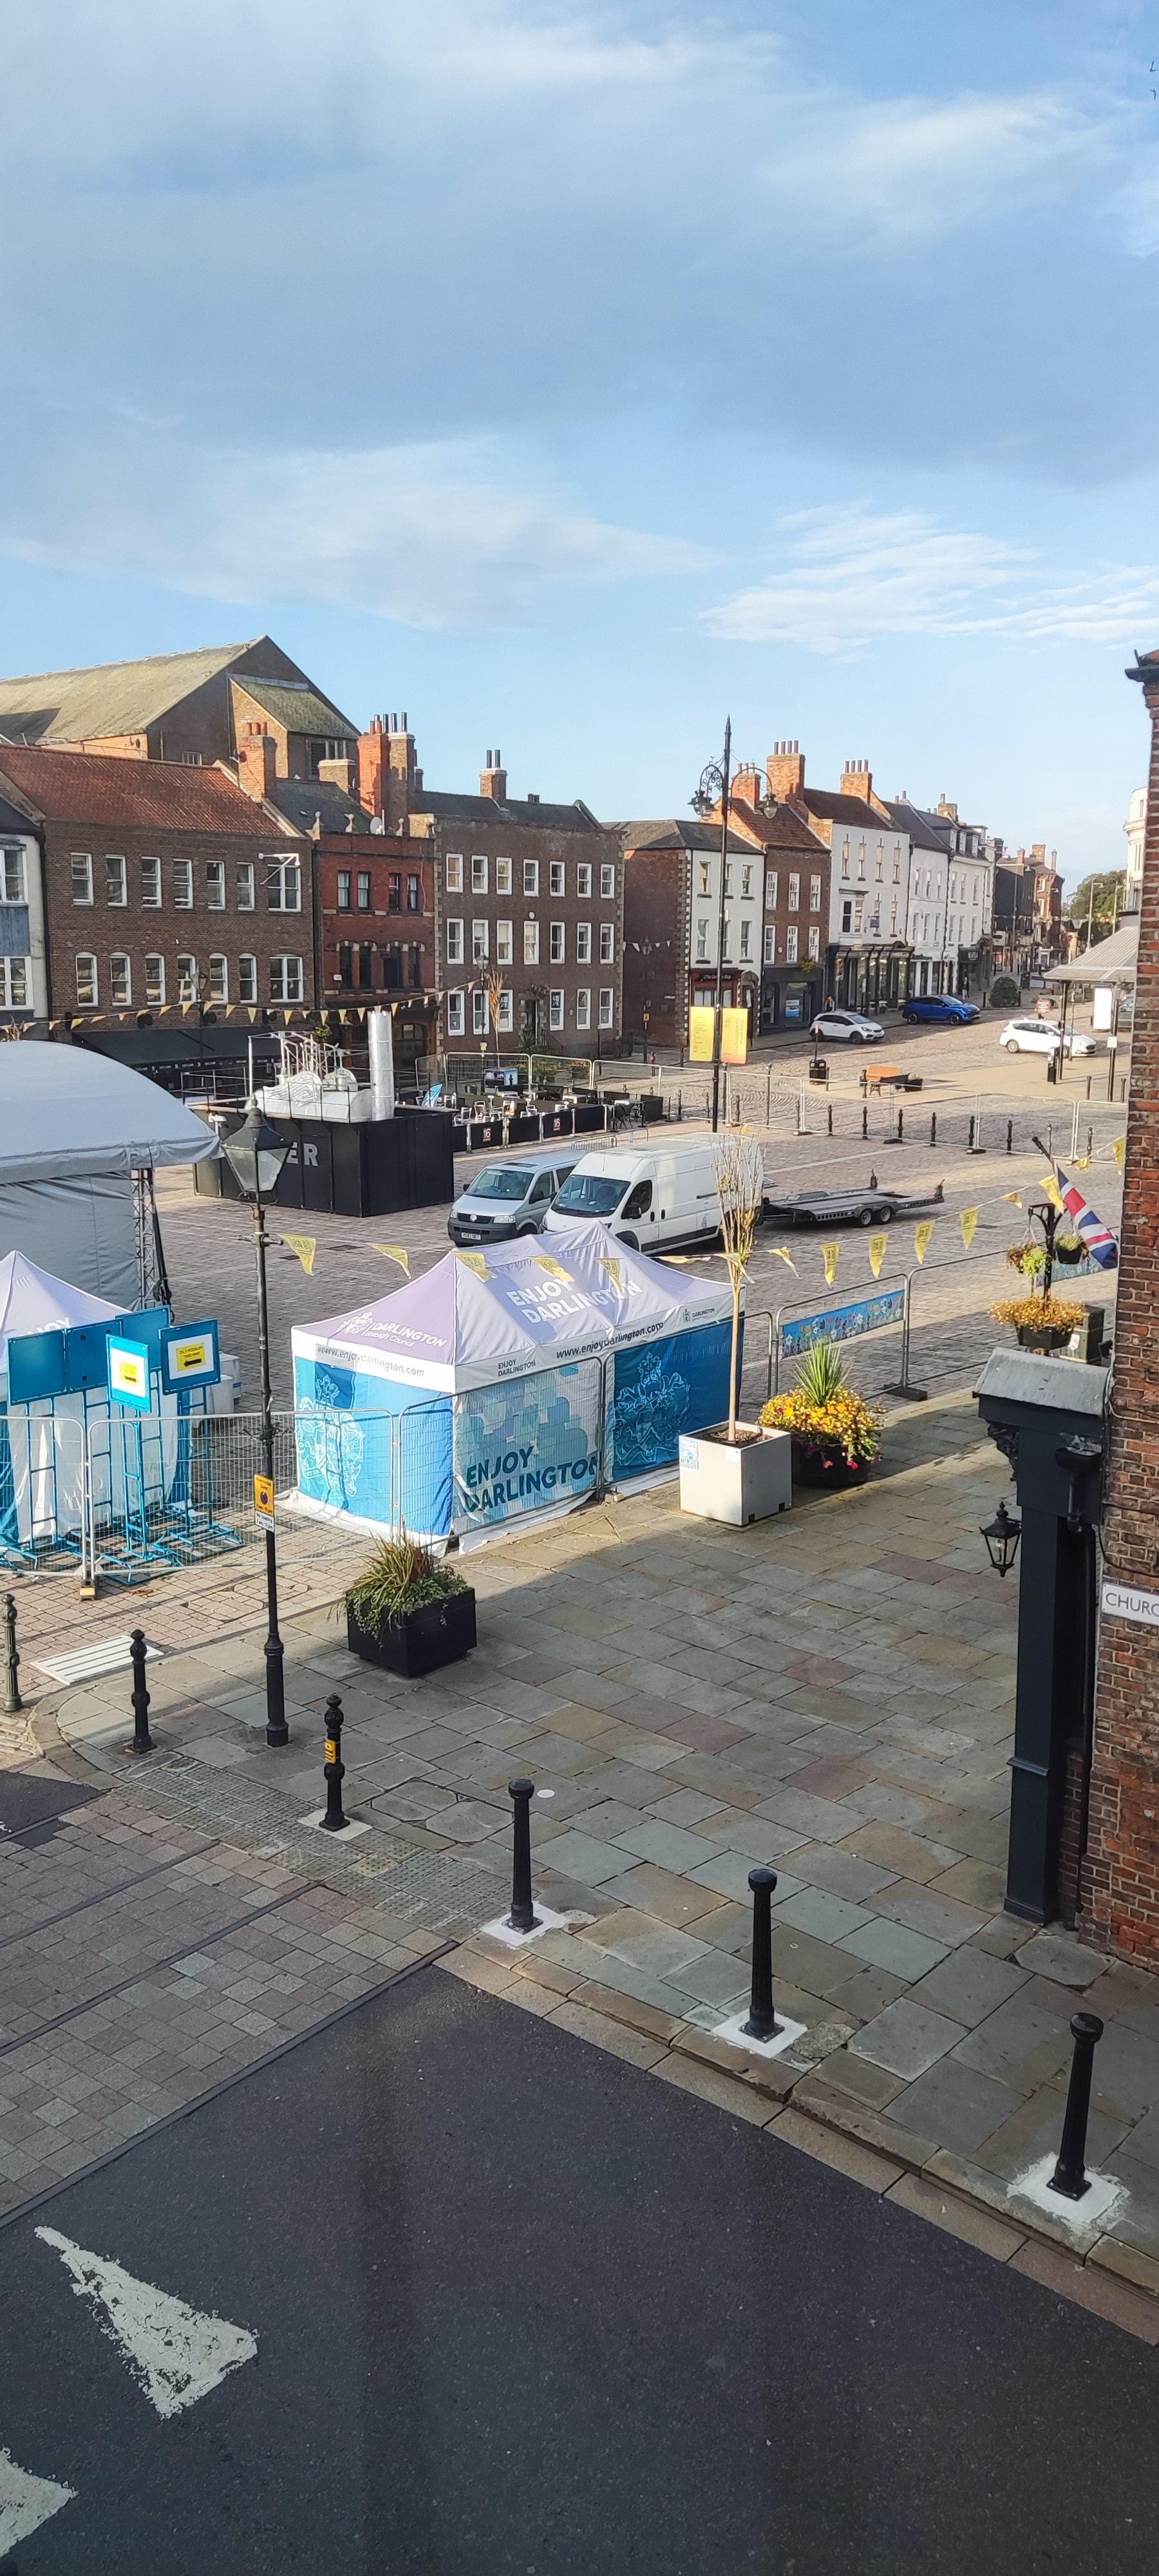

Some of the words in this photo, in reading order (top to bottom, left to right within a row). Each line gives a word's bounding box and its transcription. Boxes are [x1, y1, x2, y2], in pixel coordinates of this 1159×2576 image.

[287, 1142, 318, 1166] ER
[505, 1278, 573, 1307] ENJOY
[370, 1321, 448, 1348] DARLINGTON
[389, 1334, 417, 1348] Council
[556, 1321, 664, 1359] www.enjoydarlington.com
[317, 1345, 425, 1378] www.enjoydarlington.com
[498, 1358, 517, 1370] ENJOY
[498, 1359, 536, 1378] DARLINGTON
[466, 1446, 534, 1488] ENJOY
[463, 1455, 598, 1513] DARLINGTON
